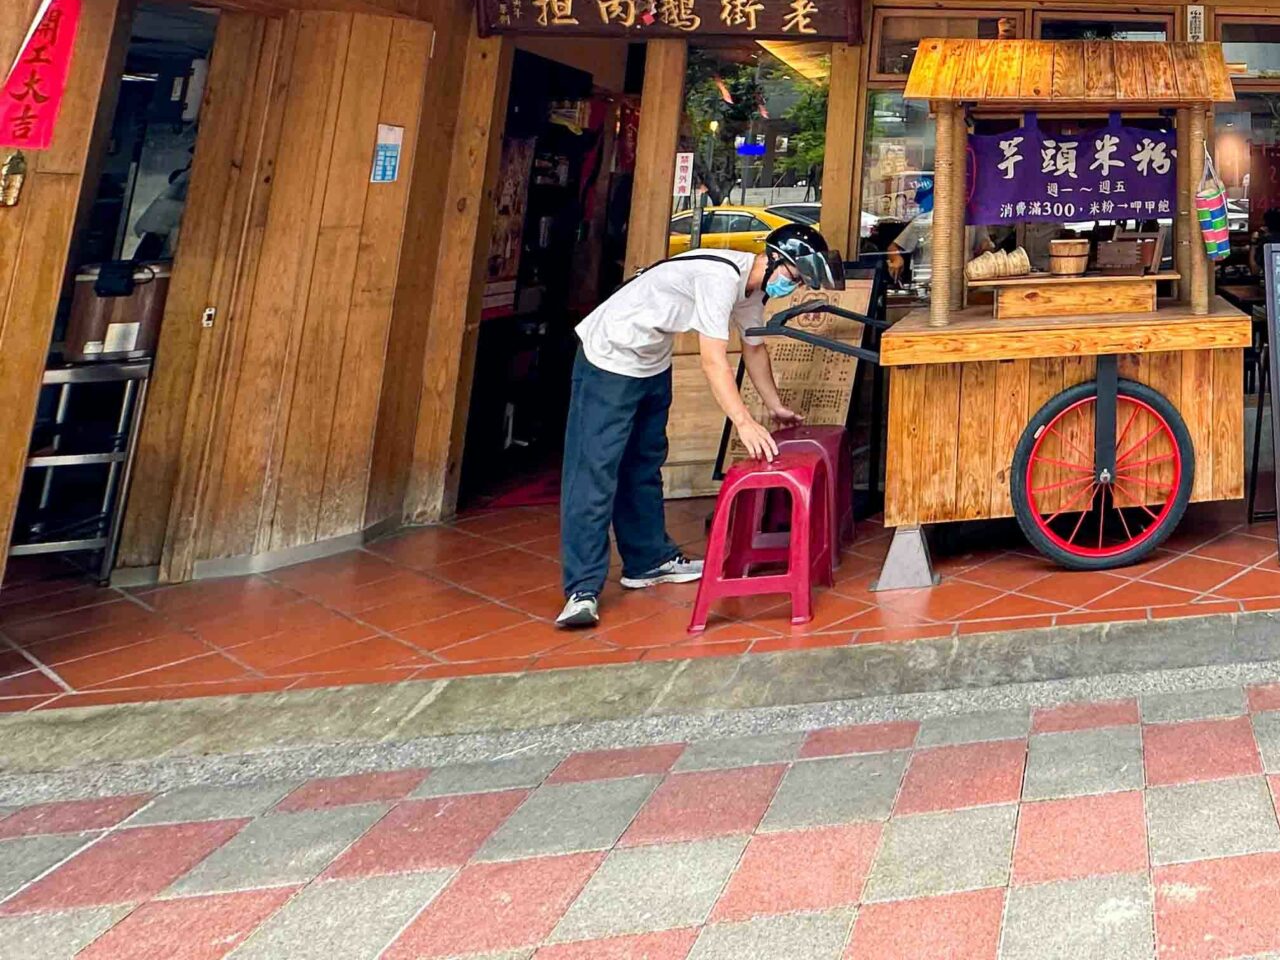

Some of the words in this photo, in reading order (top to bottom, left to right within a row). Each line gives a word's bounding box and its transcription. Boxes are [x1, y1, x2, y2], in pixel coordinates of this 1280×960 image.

[8, 8, 63, 140] 開工大吉
[997, 134, 1178, 179] 芋頭米粉
